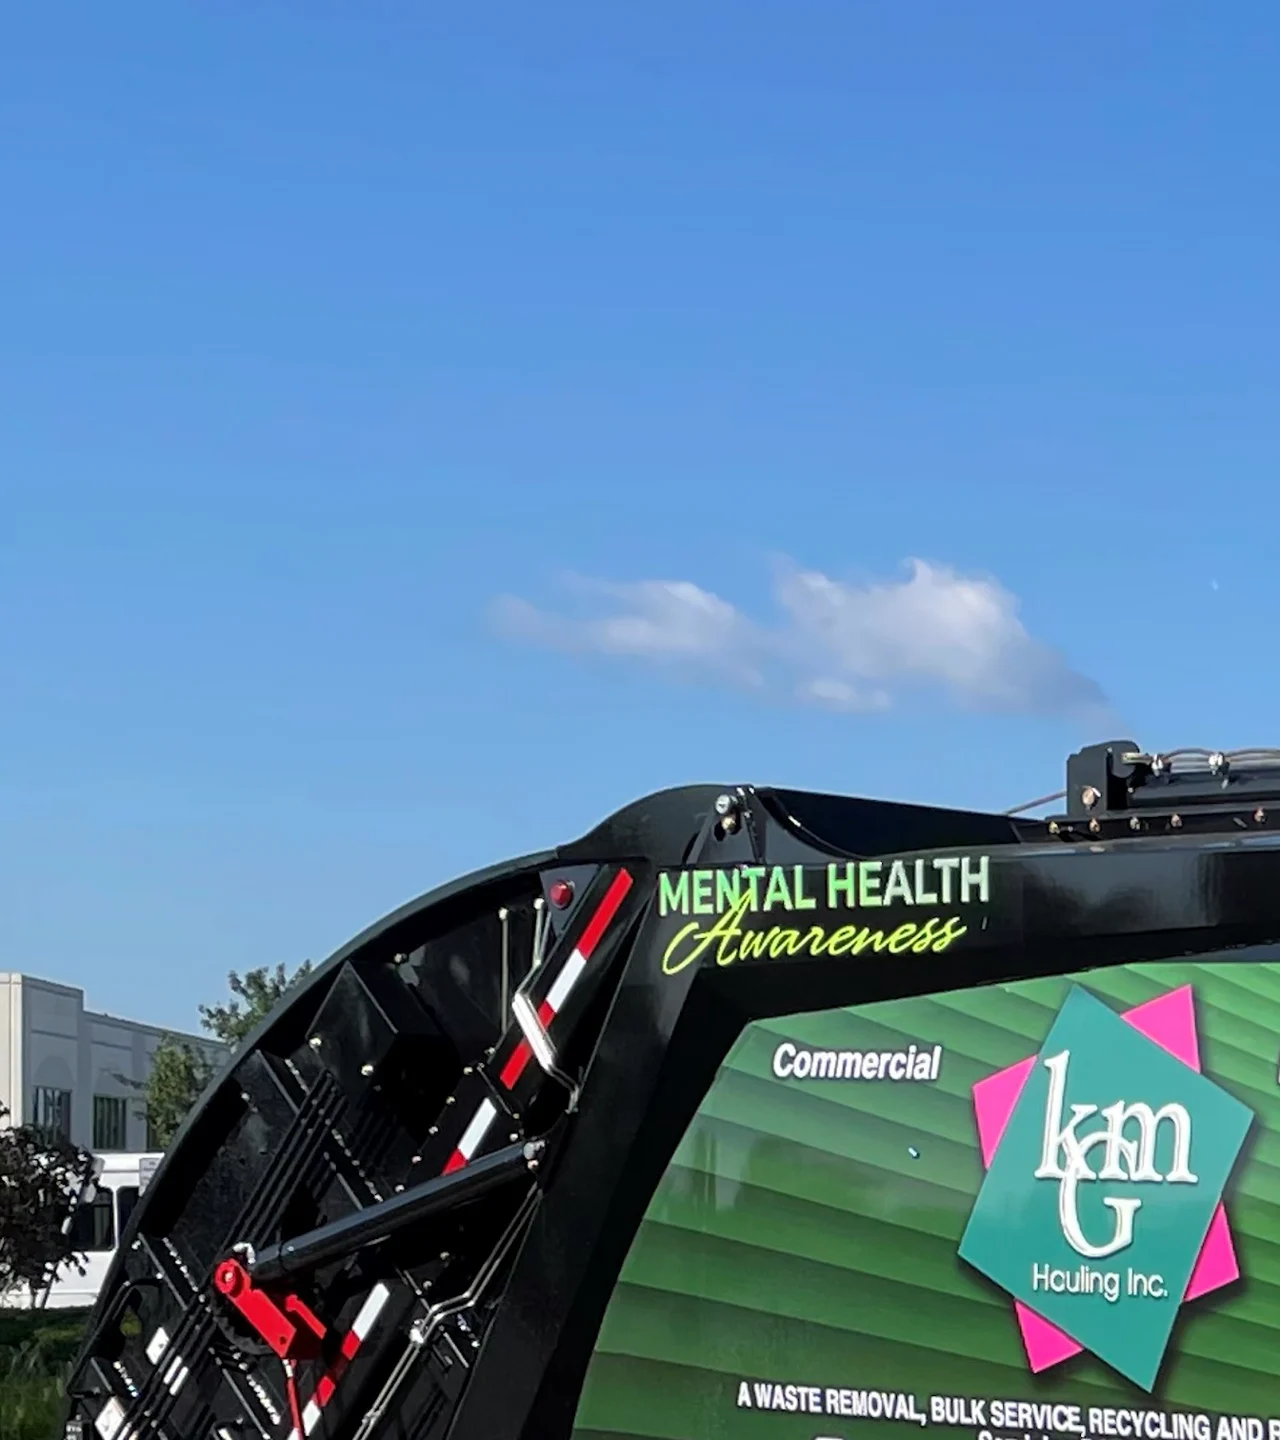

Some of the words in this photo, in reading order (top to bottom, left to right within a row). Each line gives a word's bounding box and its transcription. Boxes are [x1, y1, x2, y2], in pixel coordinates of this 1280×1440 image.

[659, 865, 816, 917] MENTAL
[827, 856, 990, 909] HEALTH
[661, 887, 968, 975] Awareness
[773, 1044, 941, 1082] Commercial
[1032, 1262, 1119, 1303] Hauling
[1127, 1267, 1168, 1297] Inc.
[737, 1381, 752, 1408] A
[754, 1383, 823, 1414] WASTE
[826, 1389, 928, 1427] REMOVAL,
[931, 1396, 987, 1425] BULK
[990, 1400, 1087, 1437] SERVICE,
